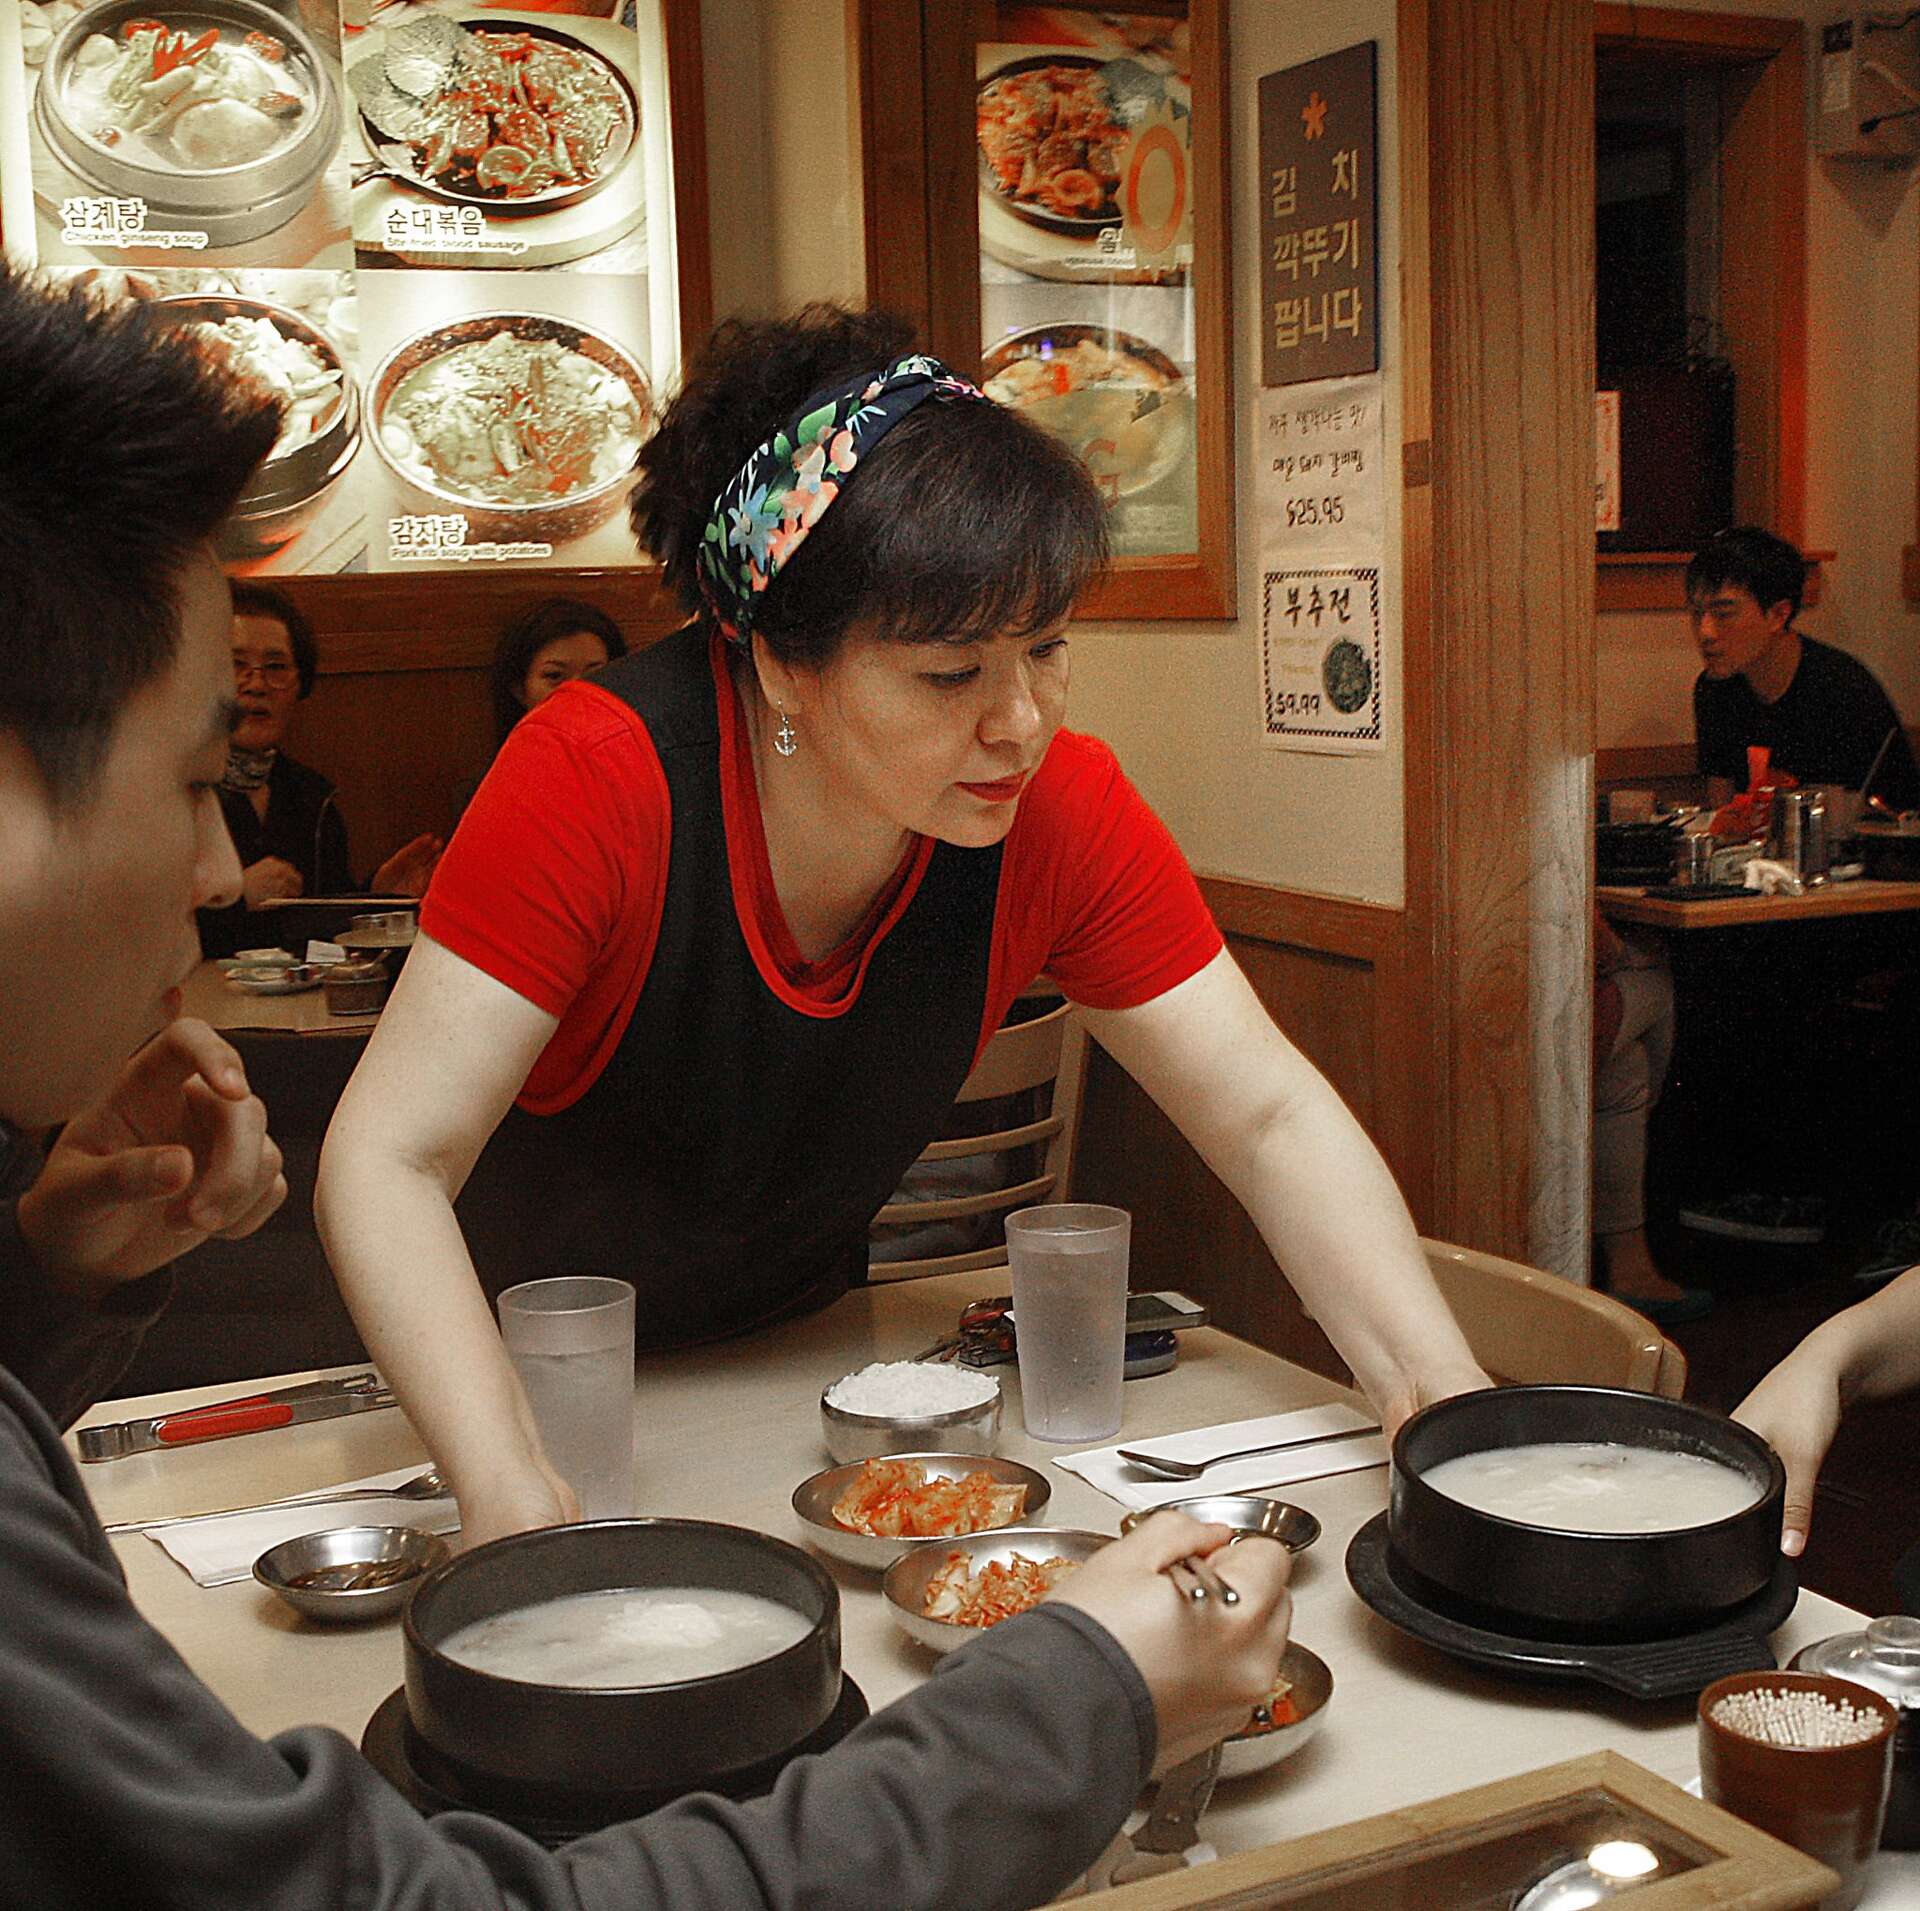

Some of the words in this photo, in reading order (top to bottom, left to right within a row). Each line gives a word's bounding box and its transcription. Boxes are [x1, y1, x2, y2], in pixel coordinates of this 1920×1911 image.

[64, 200, 143, 231] 삼계탕
[386, 208, 482, 236] 순대볶음
[1286, 495, 1344, 528] $25.95
[391, 518, 464, 545] 감자탕
[1283, 585, 1351, 628] 부추전
